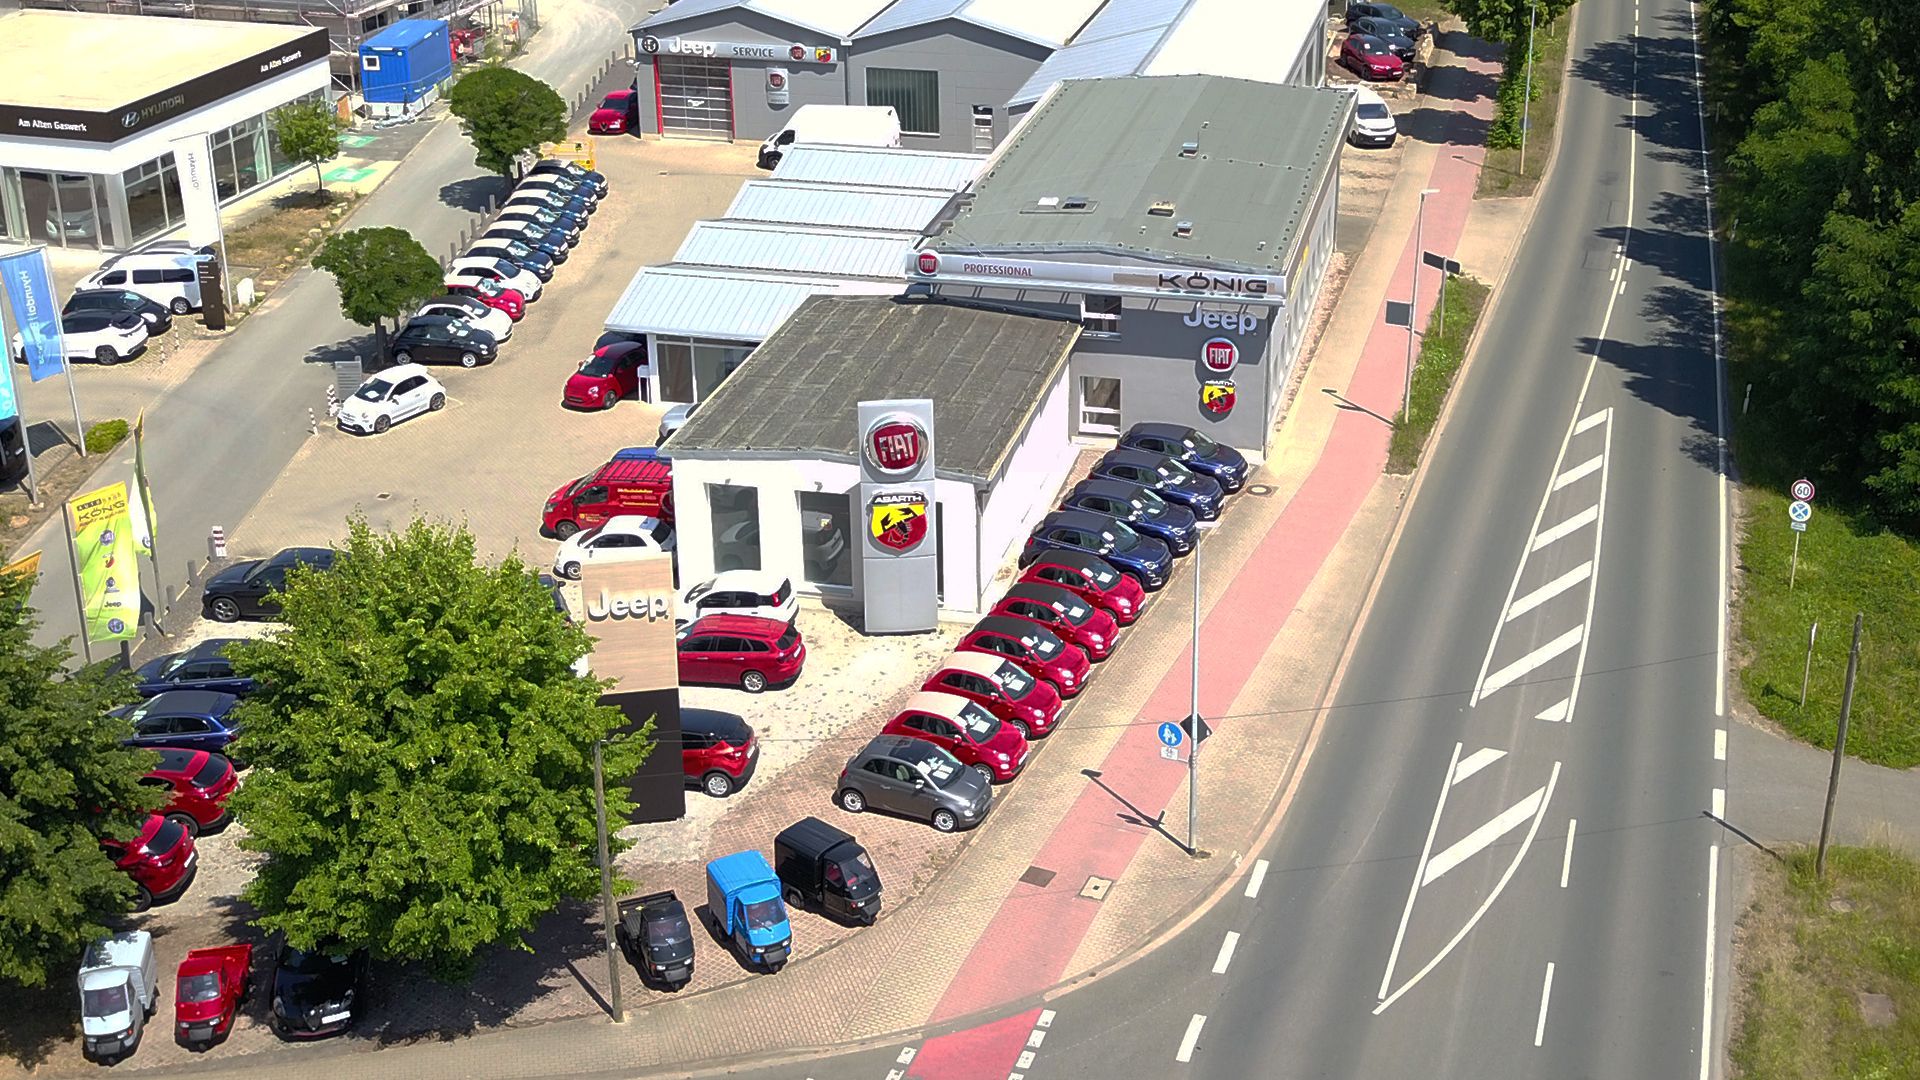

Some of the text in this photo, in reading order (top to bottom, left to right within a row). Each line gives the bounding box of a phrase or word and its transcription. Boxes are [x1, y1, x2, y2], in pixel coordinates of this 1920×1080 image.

[668, 36, 716, 58] Jeep
[732, 46, 775, 58] SERVICE
[141, 94, 185, 120] HYUNDAI
[18, 118, 87, 132] Am Alten Gaswerk
[920, 258, 1033, 277] FIAT PROFESSIONAL
[1158, 272, 1267, 293] KÖNIG
[1183, 301, 1258, 335] Jeep
[1209, 348, 1232, 365] FIAT
[879, 432, 915, 462] FIAT
[874, 495, 922, 503] ABARTH
[1797, 486, 1810, 496] 60
[79, 500, 125, 521] KÖNG
[104, 601, 122, 609] Jeep
[588, 587, 669, 623] Jeep
